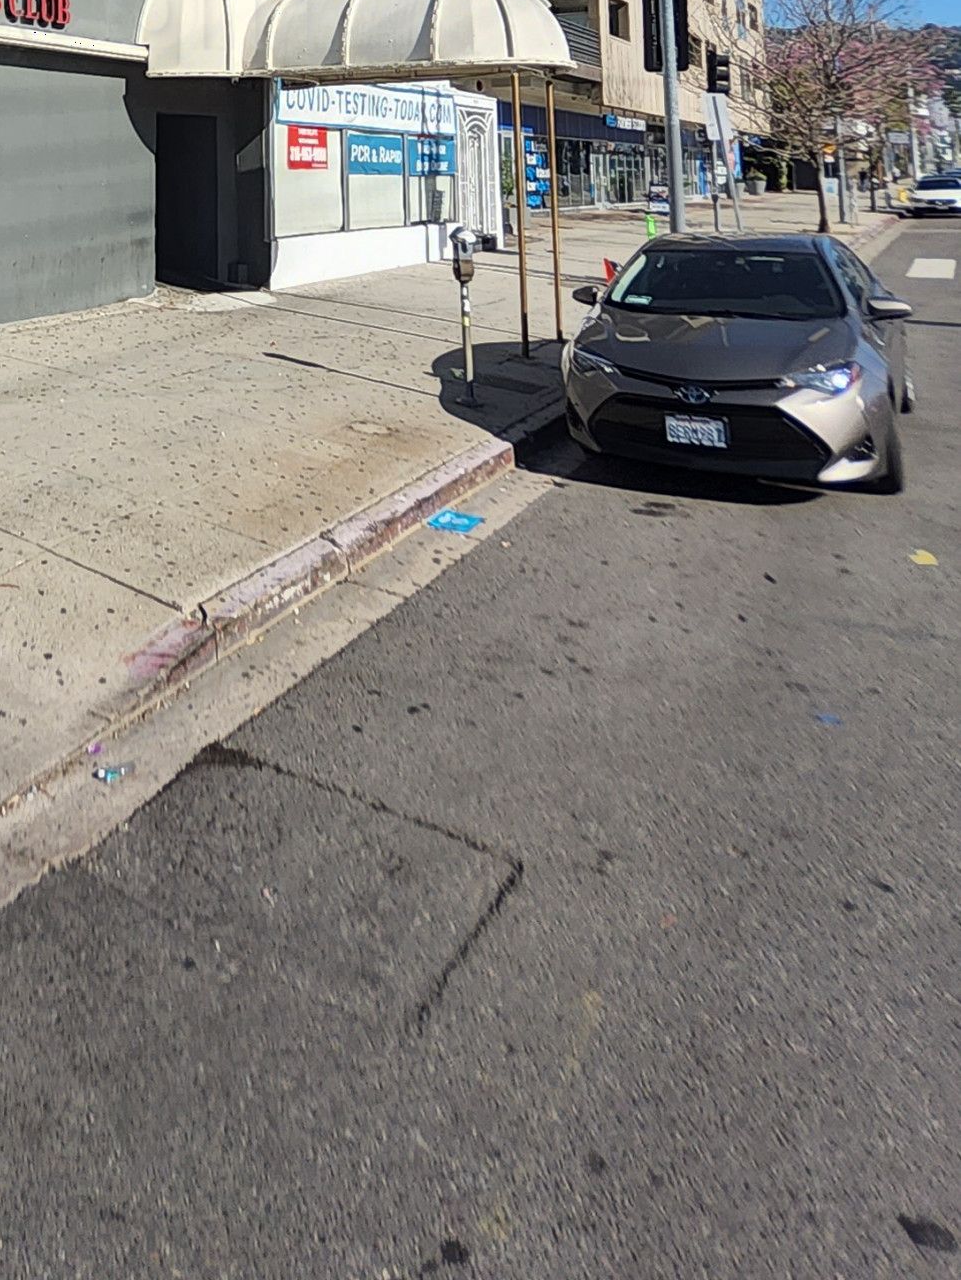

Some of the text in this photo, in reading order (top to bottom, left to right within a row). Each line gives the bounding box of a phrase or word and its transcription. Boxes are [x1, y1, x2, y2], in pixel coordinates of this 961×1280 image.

[351, 144, 370, 163] PCR
[371, 148, 378, 163] &
[379, 146, 402, 164] RAPID
